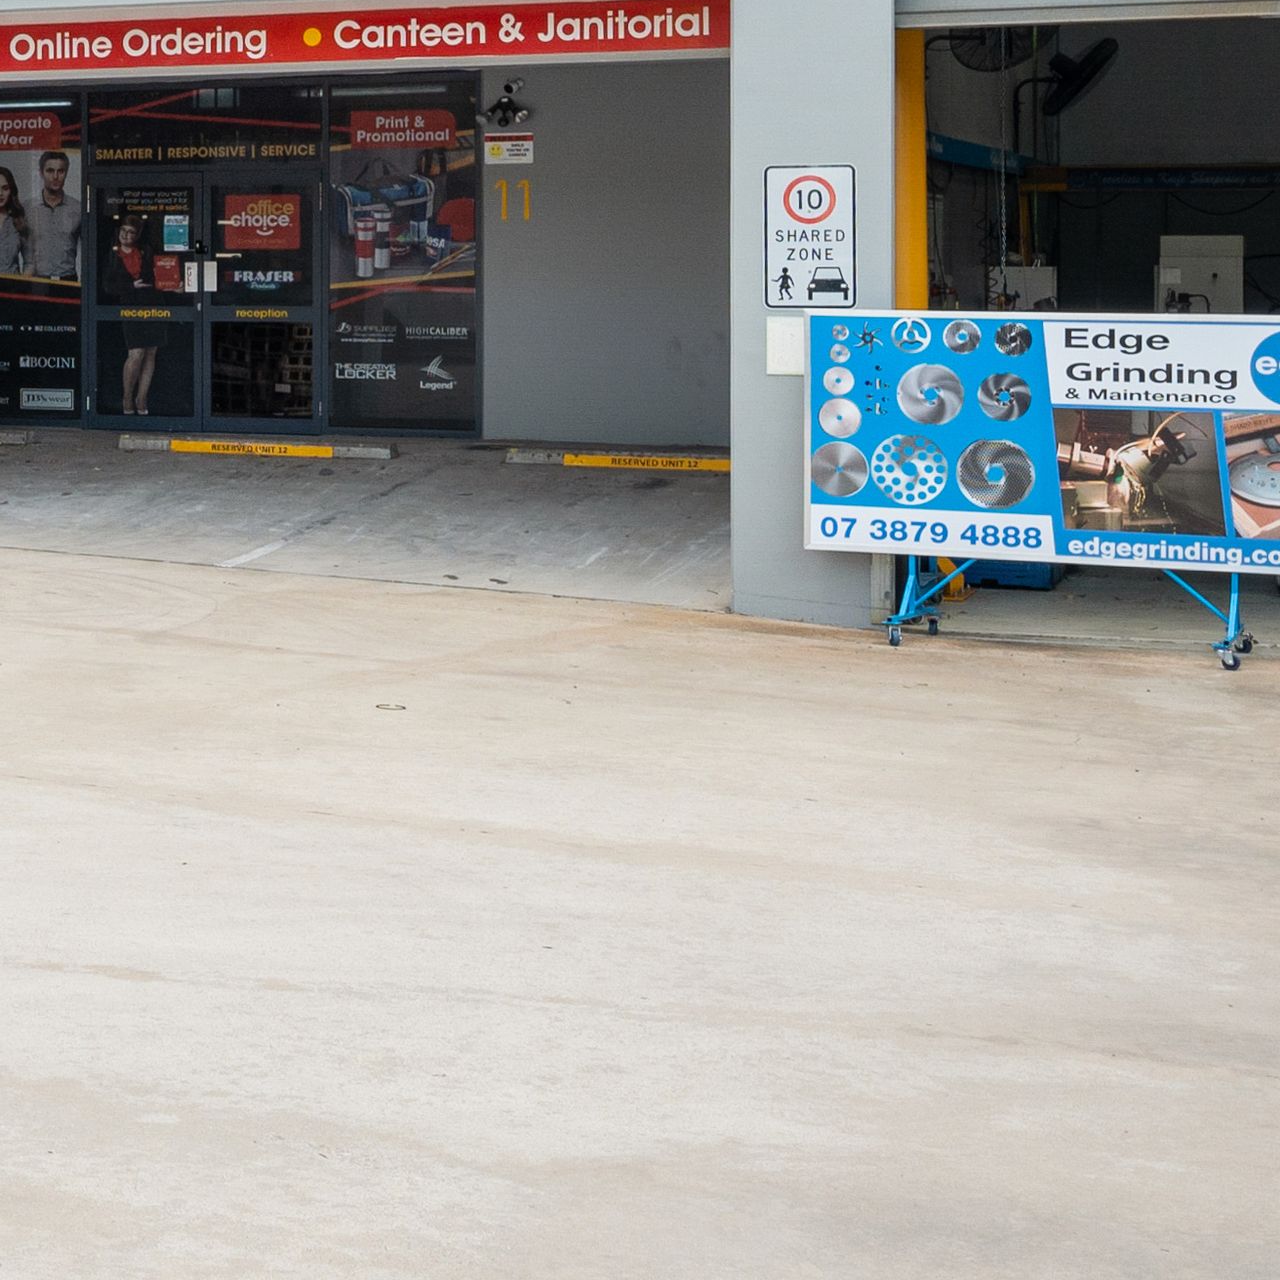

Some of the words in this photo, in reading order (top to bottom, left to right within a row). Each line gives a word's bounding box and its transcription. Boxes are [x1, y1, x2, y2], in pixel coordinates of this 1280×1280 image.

[333, 16, 488, 51] Canteen
[497, 13, 525, 41] &
[536, 6, 712, 41] Janitorial
[9, 29, 113, 61] Online
[122, 24, 268, 61] Ordering
[375, 116, 411, 130] Print
[414, 116, 425, 128] &
[356, 129, 450, 143] Promotional
[96, 148, 153, 160] SMARTER
[167, 145, 246, 159] RESPONSIVE
[261, 144, 316, 157] SERVICE
[495, 178, 534, 221] 11
[795, 189, 823, 211] 10
[247, 200, 293, 216] office
[774, 229, 846, 243] SHARED
[786, 248, 834, 261] ZONE
[234, 270, 294, 283] FRASER
[121, 308, 170, 318] reception
[236, 308, 288, 318] reception
[1064, 328, 1171, 354] Edge
[30, 357, 75, 368] BOCINI
[335, 369, 397, 380] LOCKER
[1065, 363, 1238, 390] Grinding
[420, 381, 453, 390] Legend
[1065, 388, 1080, 400] &
[1087, 387, 1237, 405] Maintenance
[820, 516, 857, 538] 07
[869, 519, 949, 543] 3879
[959, 522, 1043, 549] 4888
